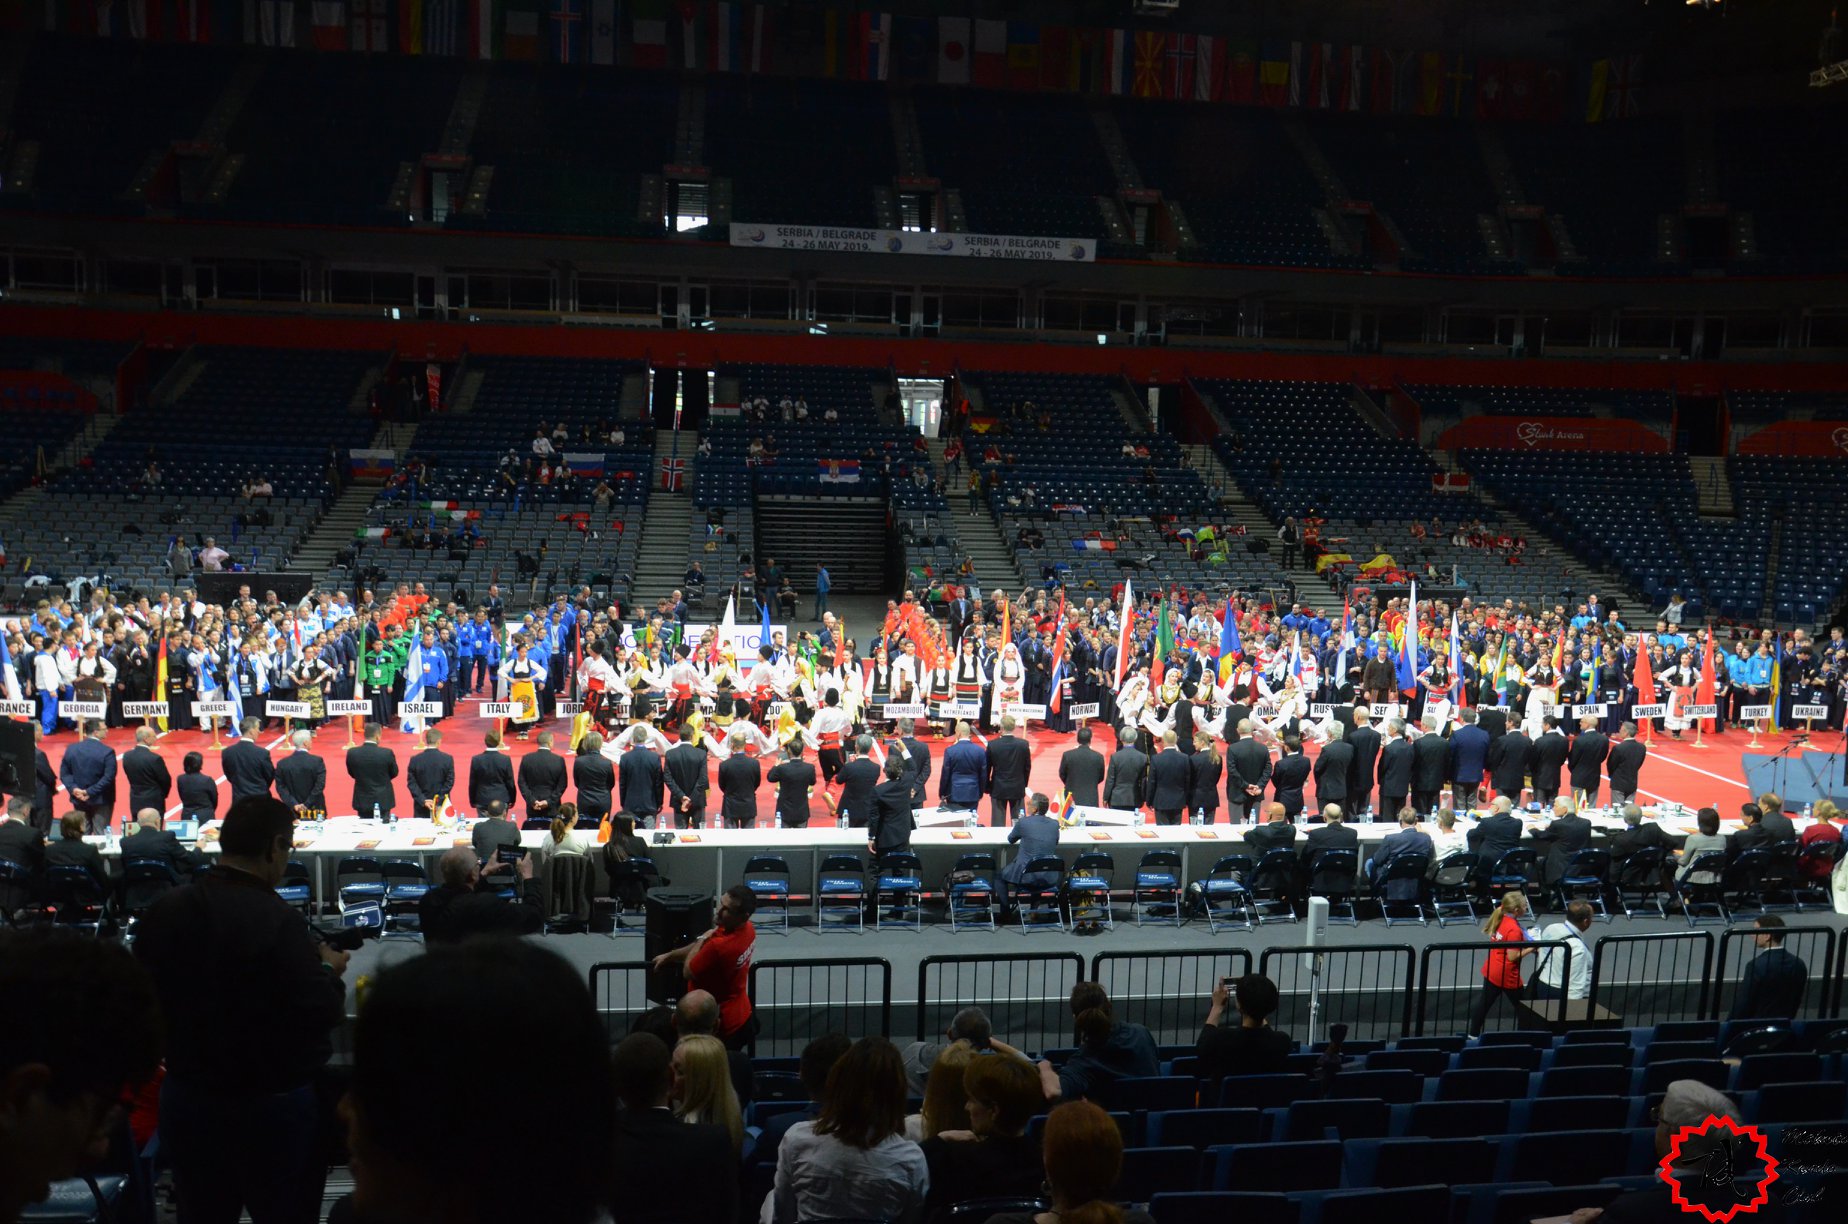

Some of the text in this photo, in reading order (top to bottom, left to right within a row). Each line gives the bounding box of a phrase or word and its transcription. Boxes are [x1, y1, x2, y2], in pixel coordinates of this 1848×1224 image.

[777, 227, 813, 237] SERBIA
[822, 229, 877, 241] BELGRADE
[782, 239, 794, 248] 24
[803, 240, 815, 249] 26
[818, 240, 840, 250] MAY
[843, 241, 871, 251] 2019.
[965, 236, 999, 246] SERBIA
[1008, 238, 1061, 249] BELGRADE
[969, 248, 981, 256] 24
[990, 249, 1001, 257] 26
[1004, 249, 1026, 258] MAY
[1029, 250, 1056, 260] 2019.
[0, 703, 31, 714] RANCE
[63, 703, 100, 713] GEORGIA
[124, 704, 167, 715] GERMANY
[200, 703, 228, 712] GREECE
[270, 704, 304, 713] HUNGARY
[331, 702, 368, 711] IRELAND
[404, 703, 434, 714] ISRAEL
[487, 703, 511, 714] ITALY
[562, 703, 584, 714] JORD
[885, 706, 923, 714] MOZAMBIQUE
[1071, 704, 1097, 715] NORWAY
[1257, 706, 1279, 717] OMAN
[1579, 705, 1600, 715] SPAIN
[1634, 706, 1663, 717] SWEDEN
[1684, 705, 1717, 715] SWITZERLAND
[1744, 707, 1769, 717] TURKEY
[1795, 706, 1824, 717] UKRAINE
